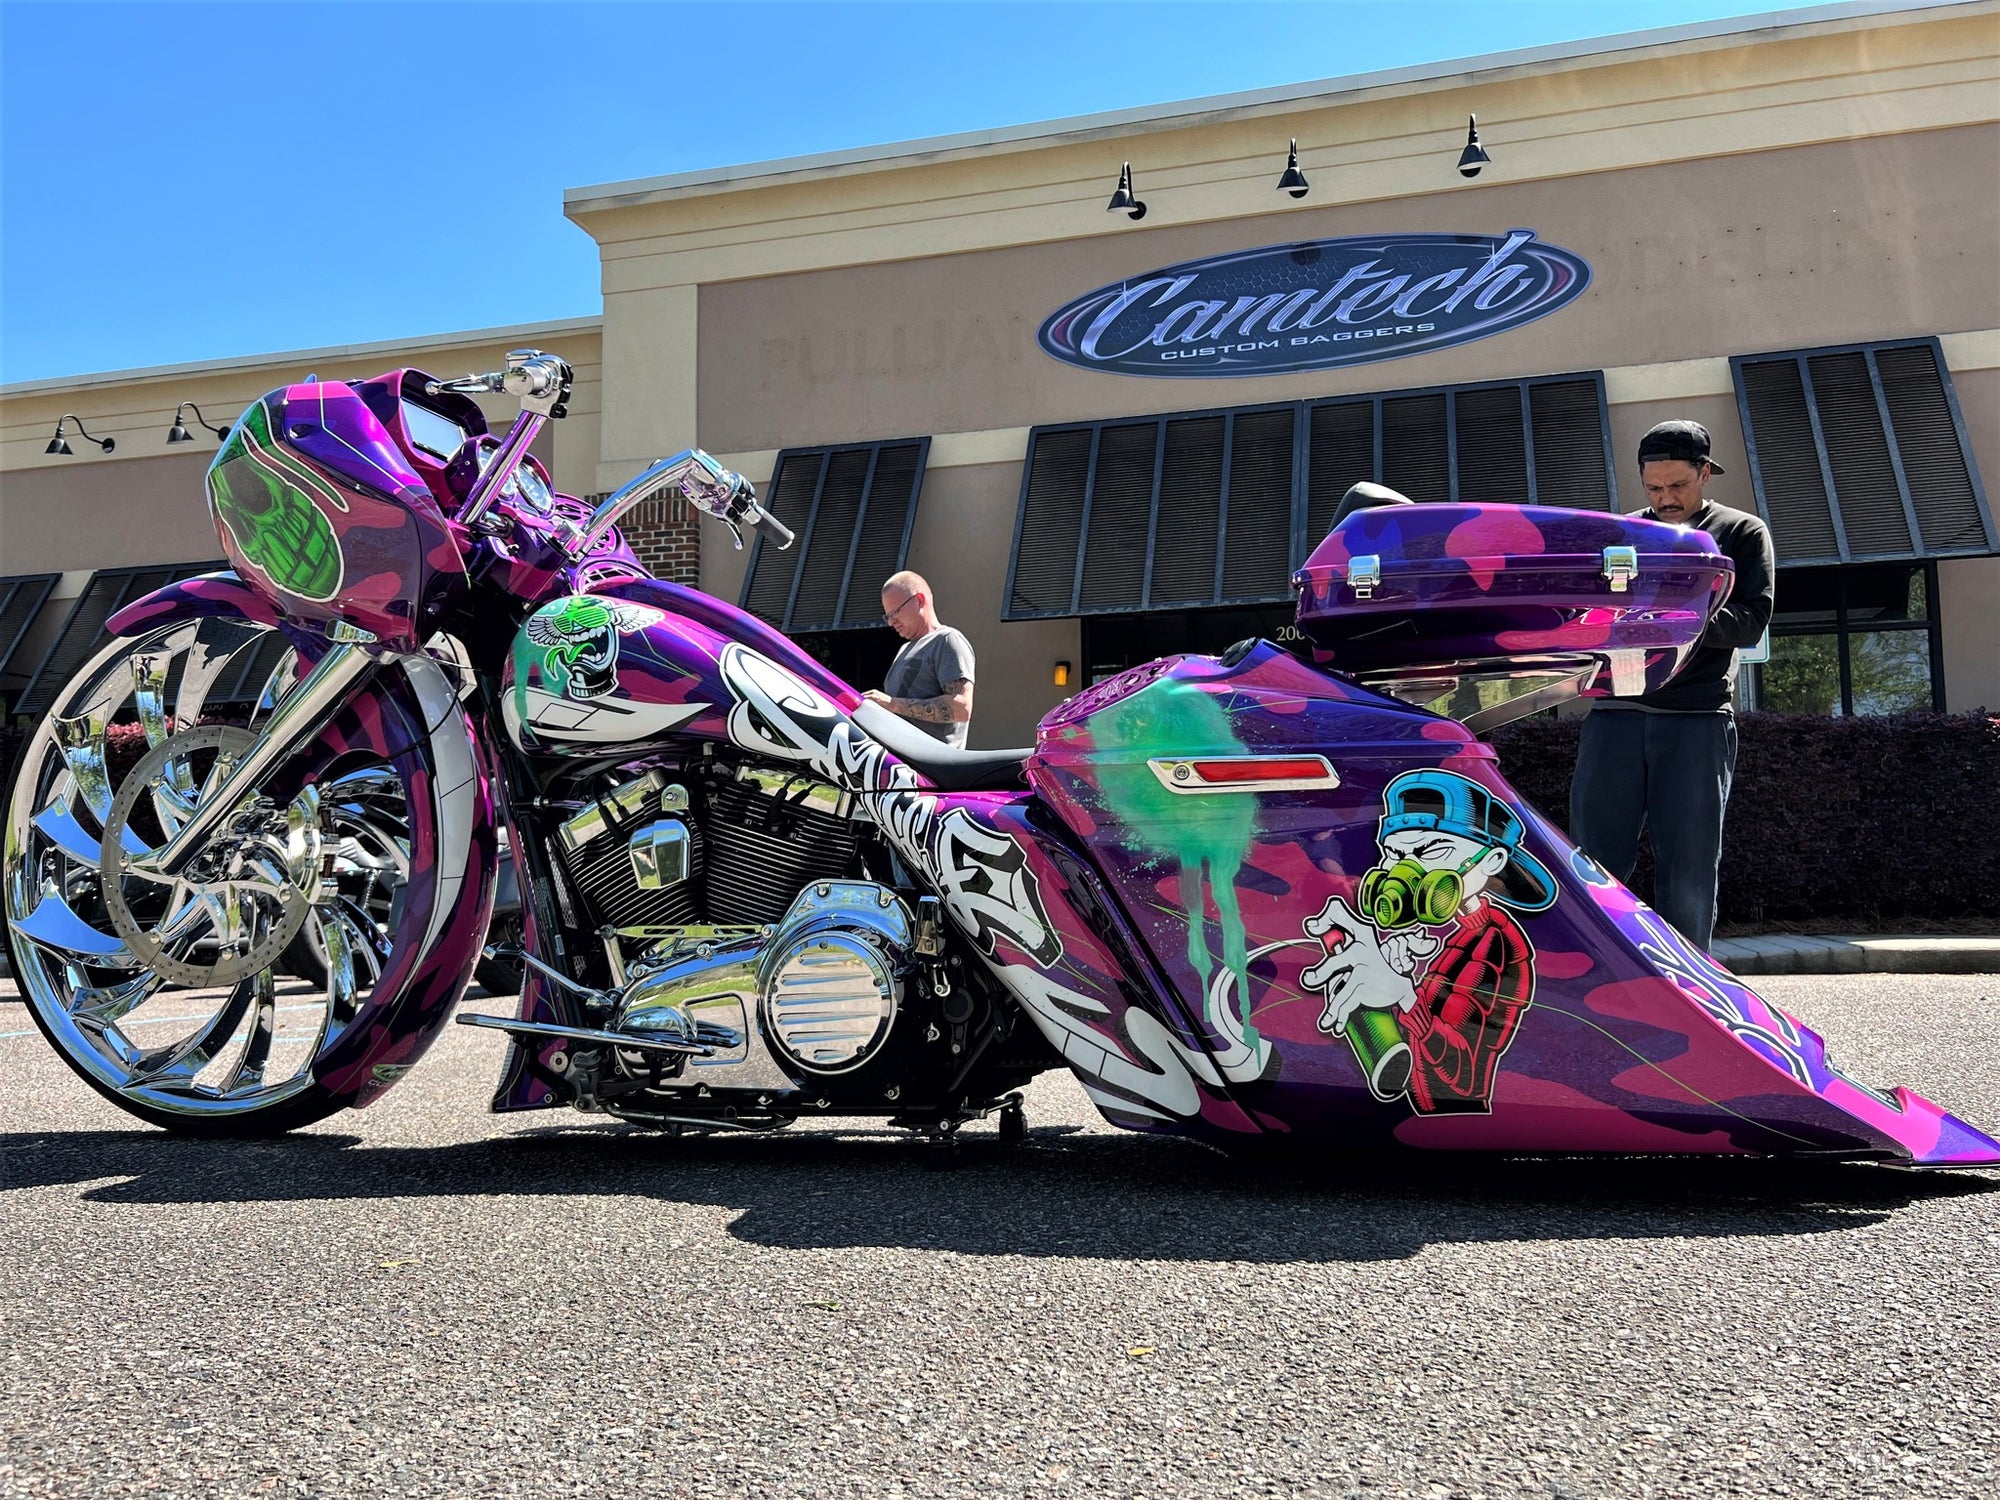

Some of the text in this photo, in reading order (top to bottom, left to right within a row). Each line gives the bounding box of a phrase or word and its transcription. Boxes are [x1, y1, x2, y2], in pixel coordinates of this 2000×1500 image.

[1080, 231, 1535, 361] Camtech
[1161, 322, 1436, 361] CUSTOM BAGGERS
